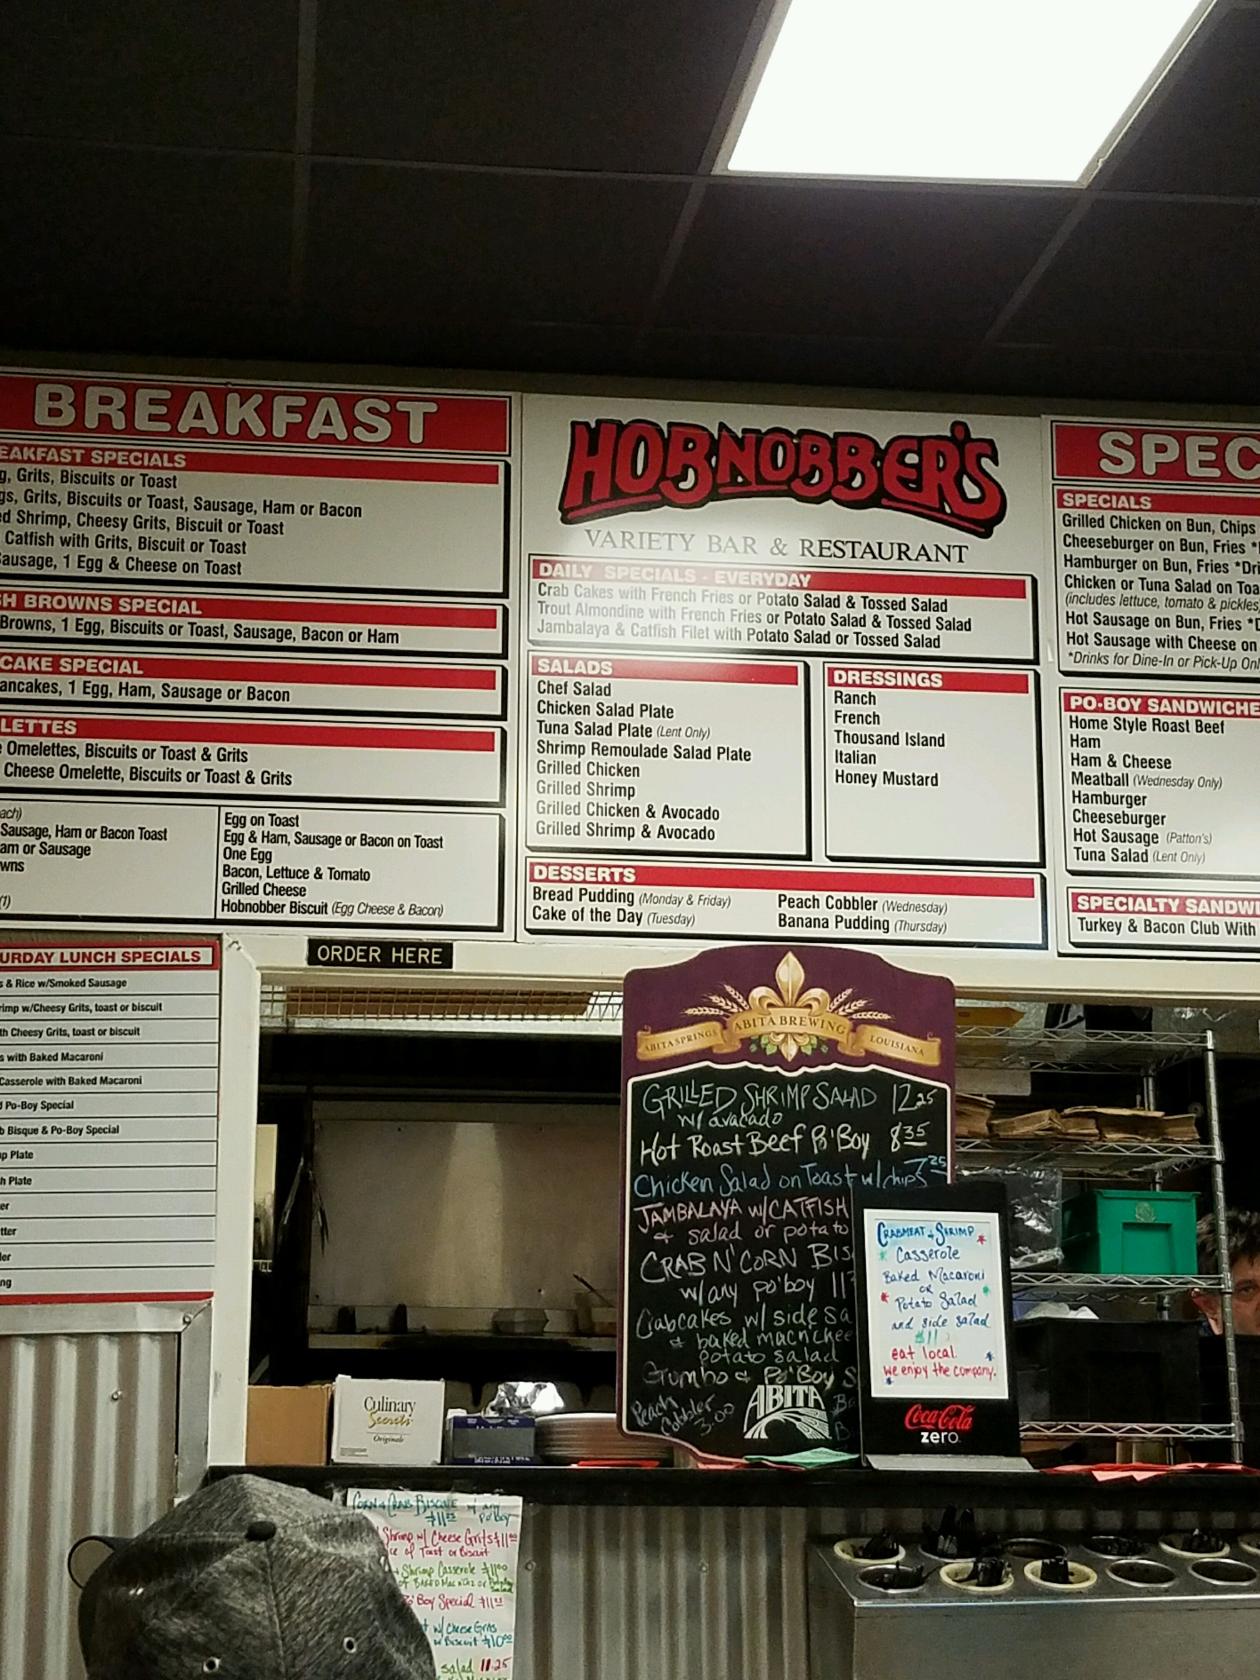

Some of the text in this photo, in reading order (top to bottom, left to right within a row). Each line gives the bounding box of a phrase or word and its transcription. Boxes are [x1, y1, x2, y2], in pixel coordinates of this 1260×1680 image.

[34, 382, 439, 445] BREAKFAST
[559, 418, 1008, 539] HOBNOBBER'S
[23, 487, 362, 518] Grits, Biscuits or Toast, Sausage, Ham or Bacon
[1062, 492, 1152, 510] SPECIALS
[1061, 512, 1256, 537] Grilled Chicken on Bun, Chips
[585, 529, 969, 563] VARIETY BAR & RESTAURANT
[1062, 532, 1246, 555] Cheeseburger on Bun, Fries
[539, 563, 811, 588] DAILY SPECIALS EVERYDAY
[23, 593, 202, 615] BROWNS SPECIAL
[537, 581, 948, 613] Crab Cakes with French Fries or Potato Salad & Tossed Salad
[537, 659, 613, 675] SALADS
[833, 670, 943, 688] DRESSINGS
[833, 689, 876, 706] Ranch
[1070, 695, 1142, 712] PO-BOY
[834, 709, 880, 725] French
[1068, 714, 1225, 734] Home Style Roast Beef
[536, 719, 710, 741] Tuna Salad Plate (Lent Only)
[833, 729, 945, 748] Thousand Island
[536, 739, 751, 762] Shrimp Remoulade Salad Plate
[834, 748, 876, 765] Italian
[834, 768, 939, 788] Honey Mustard
[1071, 770, 1223, 790] Meatball (Wednesday Only)
[224, 811, 300, 829] Egg on Toast
[1073, 827, 1213, 847] Hot Sausage (Patton's)
[222, 863, 371, 882] Bacon, Lettuce & Tomato
[533, 865, 636, 883] DESSERTS
[221, 881, 307, 897] Grilled Cheese
[532, 886, 731, 909] Bread Pudding (Monday & Friday)
[220, 898, 444, 918] Hobnobber Biscuit (Egg Cheese & Bacon)
[777, 893, 948, 916] Peach Cobbler (Wednesday)
[1077, 894, 1180, 913] SPECIALTY
[532, 905, 695, 927] Cake of the Day (Tuesday)
[778, 912, 947, 935] Banana Pudding (Thursday)
[1076, 916, 1256, 936] Turkey & Bacon Club With
[59, 950, 116, 964] LUNCH
[120, 950, 201, 963] SPECIALS
[317, 944, 443, 964] ORDER HERE
[5, 977, 127, 989] & Rice w/Smoked Sausage
[734, 1015, 847, 1036] ABITA BREWING
[869, 1034, 926, 1057] LOUISIANA
[640, 1130, 681, 1167] Hot
[686, 1133, 747, 1159] Roast
[747, 1123, 806, 1156] Beef
[633, 1197, 743, 1234] JAMBALAYA
[891, 1344, 916, 1361] eat
[932, 1361, 951, 1378] the
[363, 1395, 417, 1418] Culinary
[743, 1384, 826, 1433] ABITA
[920, 1431, 960, 1444] zero
